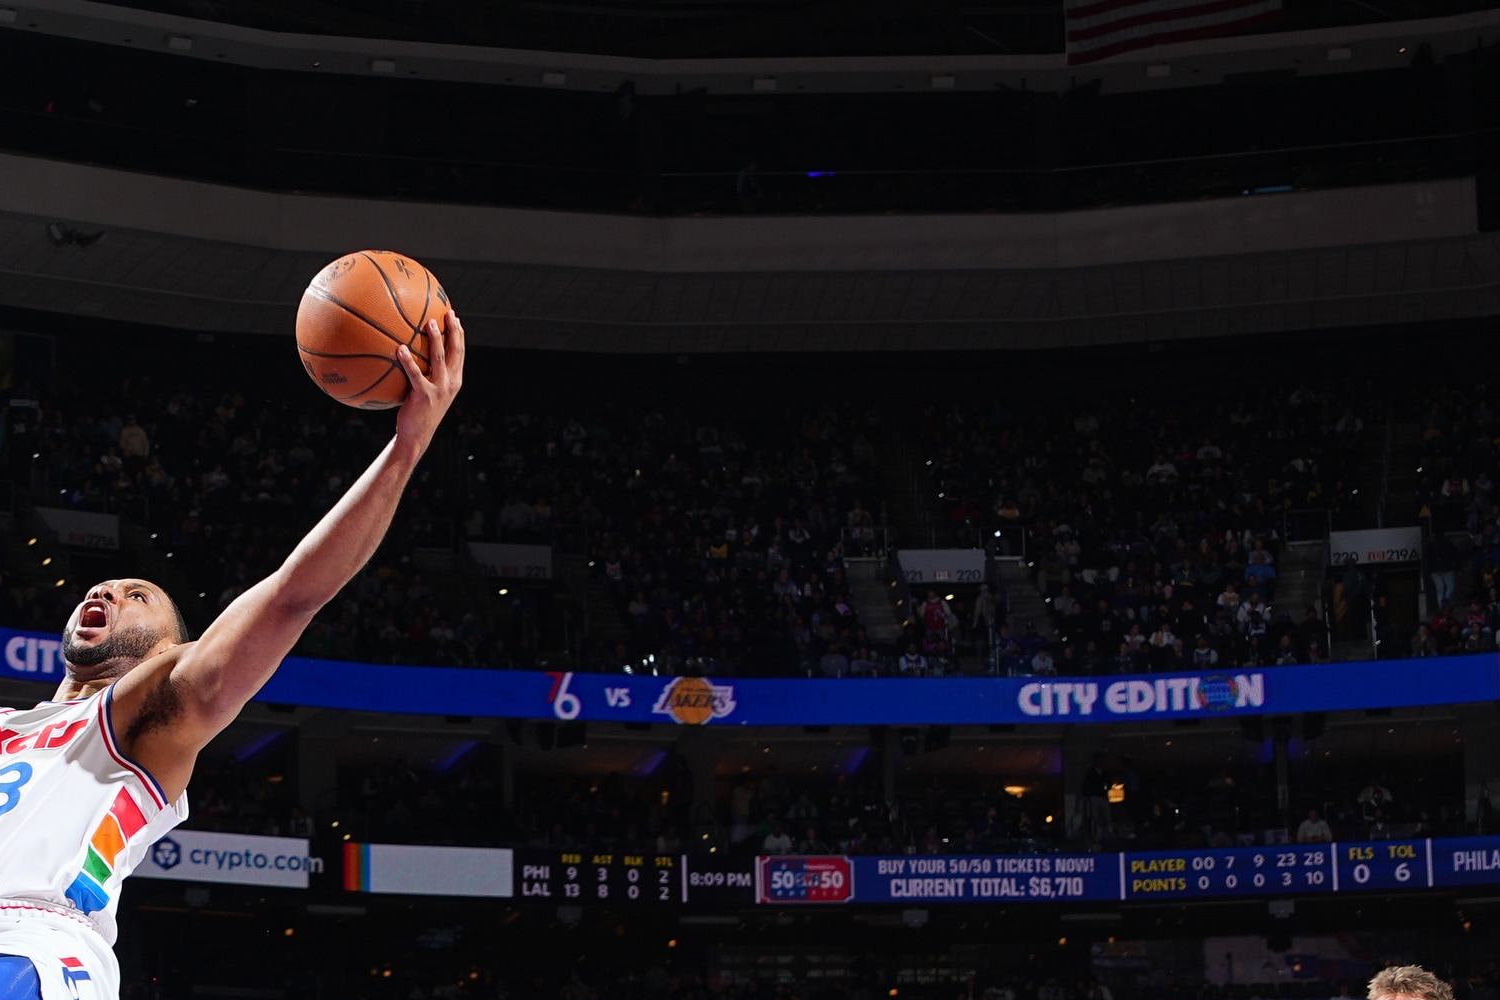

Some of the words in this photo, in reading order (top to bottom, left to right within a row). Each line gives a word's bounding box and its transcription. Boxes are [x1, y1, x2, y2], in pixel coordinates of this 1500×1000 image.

[5, 636, 65, 673] CIT
[604, 687, 631, 708] VS
[1017, 682, 1099, 716] CITY
[190, 849, 325, 874] crypto.com
[593, 854, 613, 865] AST
[624, 856, 644, 866] BLK
[655, 857, 673, 867] STL
[1131, 858, 1186, 873] PLAYER
[1192, 856, 1215, 870] 00
[1225, 856, 1235, 869] 7
[1253, 854, 1264, 867] 9
[1276, 852, 1296, 867] 23
[1303, 852, 1324, 866] 28
[1349, 847, 1374, 860] FLS
[1388, 845, 1416, 859] TOL
[522, 865, 550, 879] PHI
[566, 867, 577, 879] 9
[597, 867, 607, 880] 3
[628, 868, 639, 882] 0
[659, 870, 669, 883] 2
[878, 859, 905, 874] BUY
[909, 859, 946, 874] YOUR
[950, 858, 991, 874] 50/50
[996, 858, 1051, 873] TICKETS
[1055, 857, 1095, 873] NOW!
[1353, 863, 1370, 883] 0
[1394, 862, 1411, 882] 6
[690, 872, 723, 885] 8:09
[727, 872, 751, 886] PM
[771, 871, 795, 889] 50
[820, 871, 844, 889] 50
[890, 878, 965, 897] CURRENT
[970, 877, 1025, 896] TOTAL:
[1029, 876, 1084, 898] $6,710
[1132, 877, 1187, 892] POINTS
[1198, 876, 1210, 889] 0
[1225, 874, 1237, 888] 0
[1253, 873, 1265, 887] 0
[1282, 872, 1292, 886] 3
[1305, 871, 1324, 885] 10
[522, 882, 551, 897] LAL
[564, 884, 580, 897] 13
[628, 885, 639, 899] 0
[659, 886, 669, 900] 2
